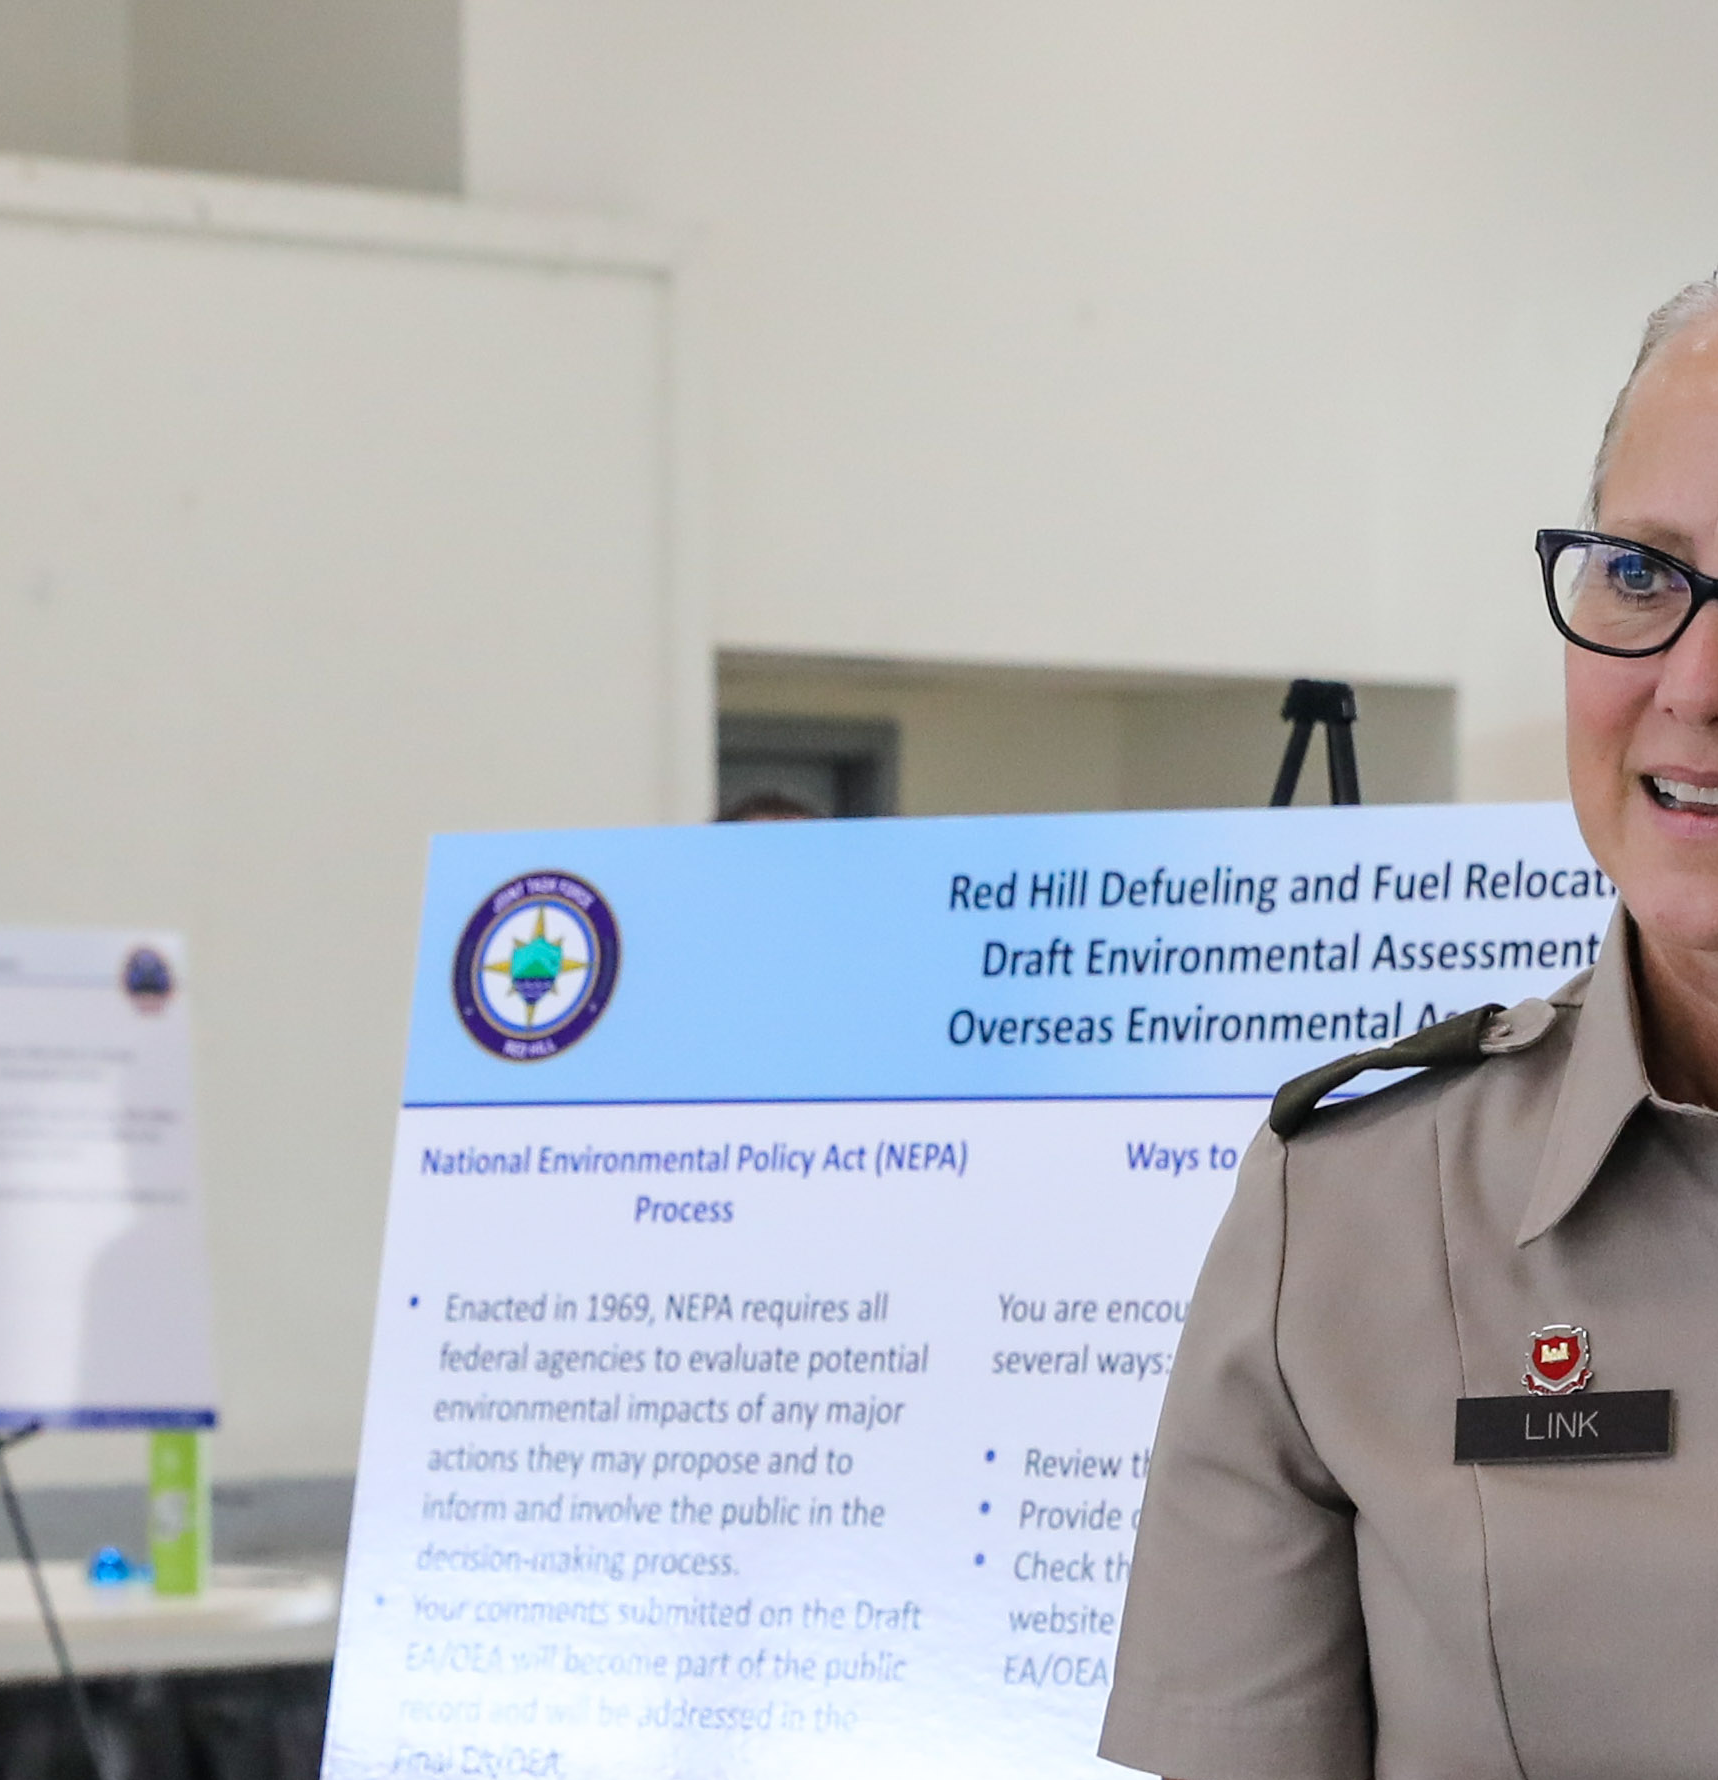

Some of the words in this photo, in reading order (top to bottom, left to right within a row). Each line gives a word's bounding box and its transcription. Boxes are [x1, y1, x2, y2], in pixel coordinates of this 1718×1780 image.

[950, 871, 1017, 910] Red
[1030, 870, 1088, 909] Hill
[1101, 866, 1278, 913] Defueling
[1290, 864, 1360, 903] and
[1374, 862, 1451, 901] Fuel
[983, 938, 1074, 977] Draft
[1087, 933, 1360, 974] Environmental
[1372, 934, 1600, 970] Assessment
[949, 1009, 1113, 1046] Overseas
[1127, 1001, 1402, 1043] Environmental
[1418, 1003, 1459, 1029] A
[422, 1146, 531, 1175] National
[538, 1143, 730, 1174] Environmental
[737, 1143, 815, 1178] Policy
[823, 1144, 866, 1171] Act
[876, 1141, 967, 1176] (NEPA)
[1127, 1142, 1199, 1176] Ways
[1210, 1144, 1237, 1170] to
[635, 1195, 733, 1223] Process
[445, 1293, 548, 1322] Enacted
[554, 1293, 577, 1321] in
[587, 1293, 655, 1326] 1969,
[666, 1293, 733, 1322] NEPA
[742, 1294, 849, 1327] requires
[857, 1292, 888, 1322] all
[999, 1294, 1046, 1323] You
[1054, 1300, 1098, 1323] are
[440, 1341, 529, 1372] federal
[534, 1344, 646, 1379] agencies
[655, 1347, 681, 1372] to
[688, 1343, 800, 1373] evaluate
[808, 1343, 929, 1379] potential
[993, 1344, 1089, 1374] several
[434, 1393, 620, 1423] environmental
[628, 1395, 729, 1428] impacts
[737, 1393, 766, 1423] of
[771, 1401, 819, 1431] any
[826, 1396, 905, 1431] major
[1524, 1410, 1599, 1441] LINK
[427, 1446, 519, 1472] actions
[527, 1443, 584, 1478] they
[591, 1451, 646, 1479] may
[653, 1451, 760, 1480] propose
[768, 1446, 818, 1475] and
[826, 1449, 853, 1475] to
[1025, 1448, 1122, 1478] Review
[422, 1491, 507, 1522] inform
[514, 1493, 564, 1523] and
[570, 1494, 662, 1524] involve
[670, 1495, 713, 1525] the
[720, 1496, 800, 1530] public
[809, 1498, 832, 1526] in
[842, 1497, 885, 1527] the
[1020, 1500, 1122, 1530] Provide
[416, 1542, 626, 1582] decision-making
[631, 1552, 739, 1582] process.
[1014, 1551, 1095, 1582] Check
[413, 1594, 471, 1622] Your
[474, 1600, 610, 1627] comments
[618, 1596, 753, 1627] submitted
[759, 1605, 793, 1627] on
[802, 1599, 845, 1630] the
[855, 1600, 922, 1630] Draft
[1009, 1603, 1116, 1635] website
[1003, 1653, 1109, 1688] EA/OEA
